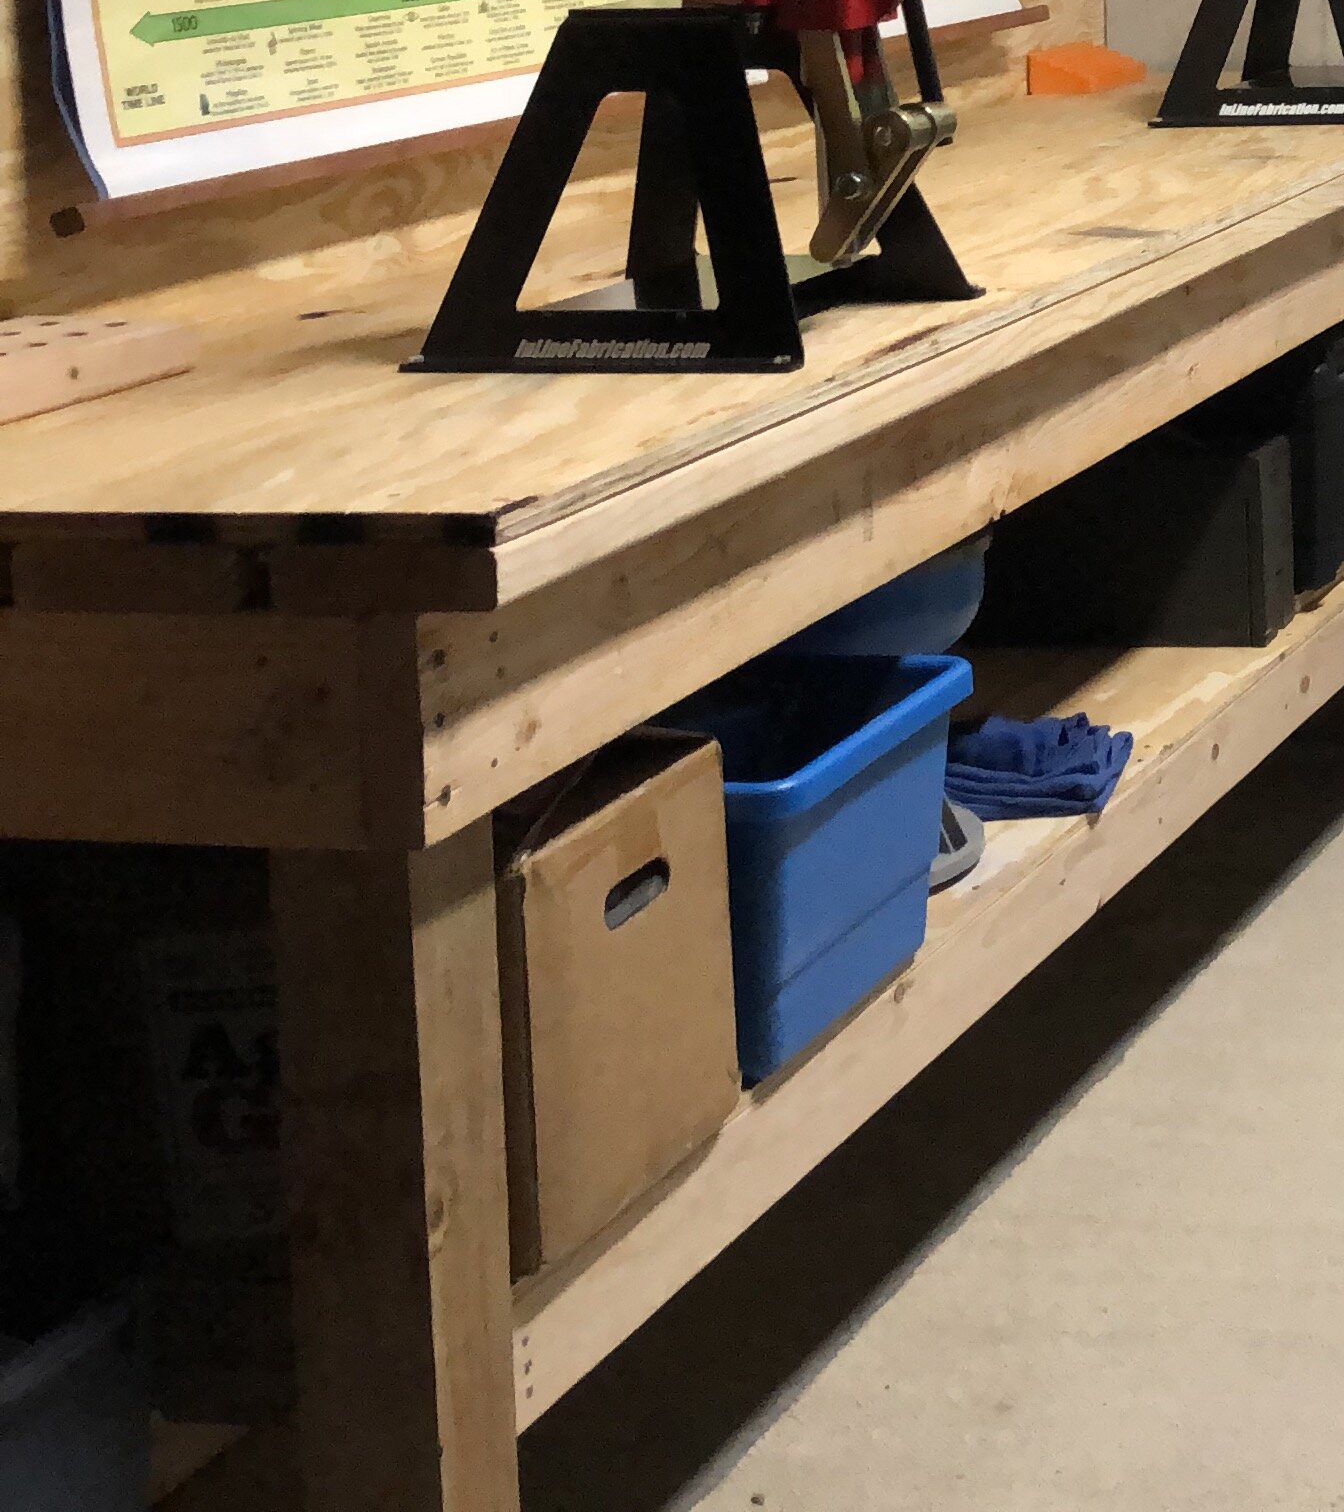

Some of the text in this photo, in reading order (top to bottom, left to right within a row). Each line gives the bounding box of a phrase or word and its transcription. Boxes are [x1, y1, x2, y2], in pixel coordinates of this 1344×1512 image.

[172, 16, 198, 32] 1500
[121, 95, 165, 110] TIME LINE
[514, 338, 711, 361] InLineFabrication.com
